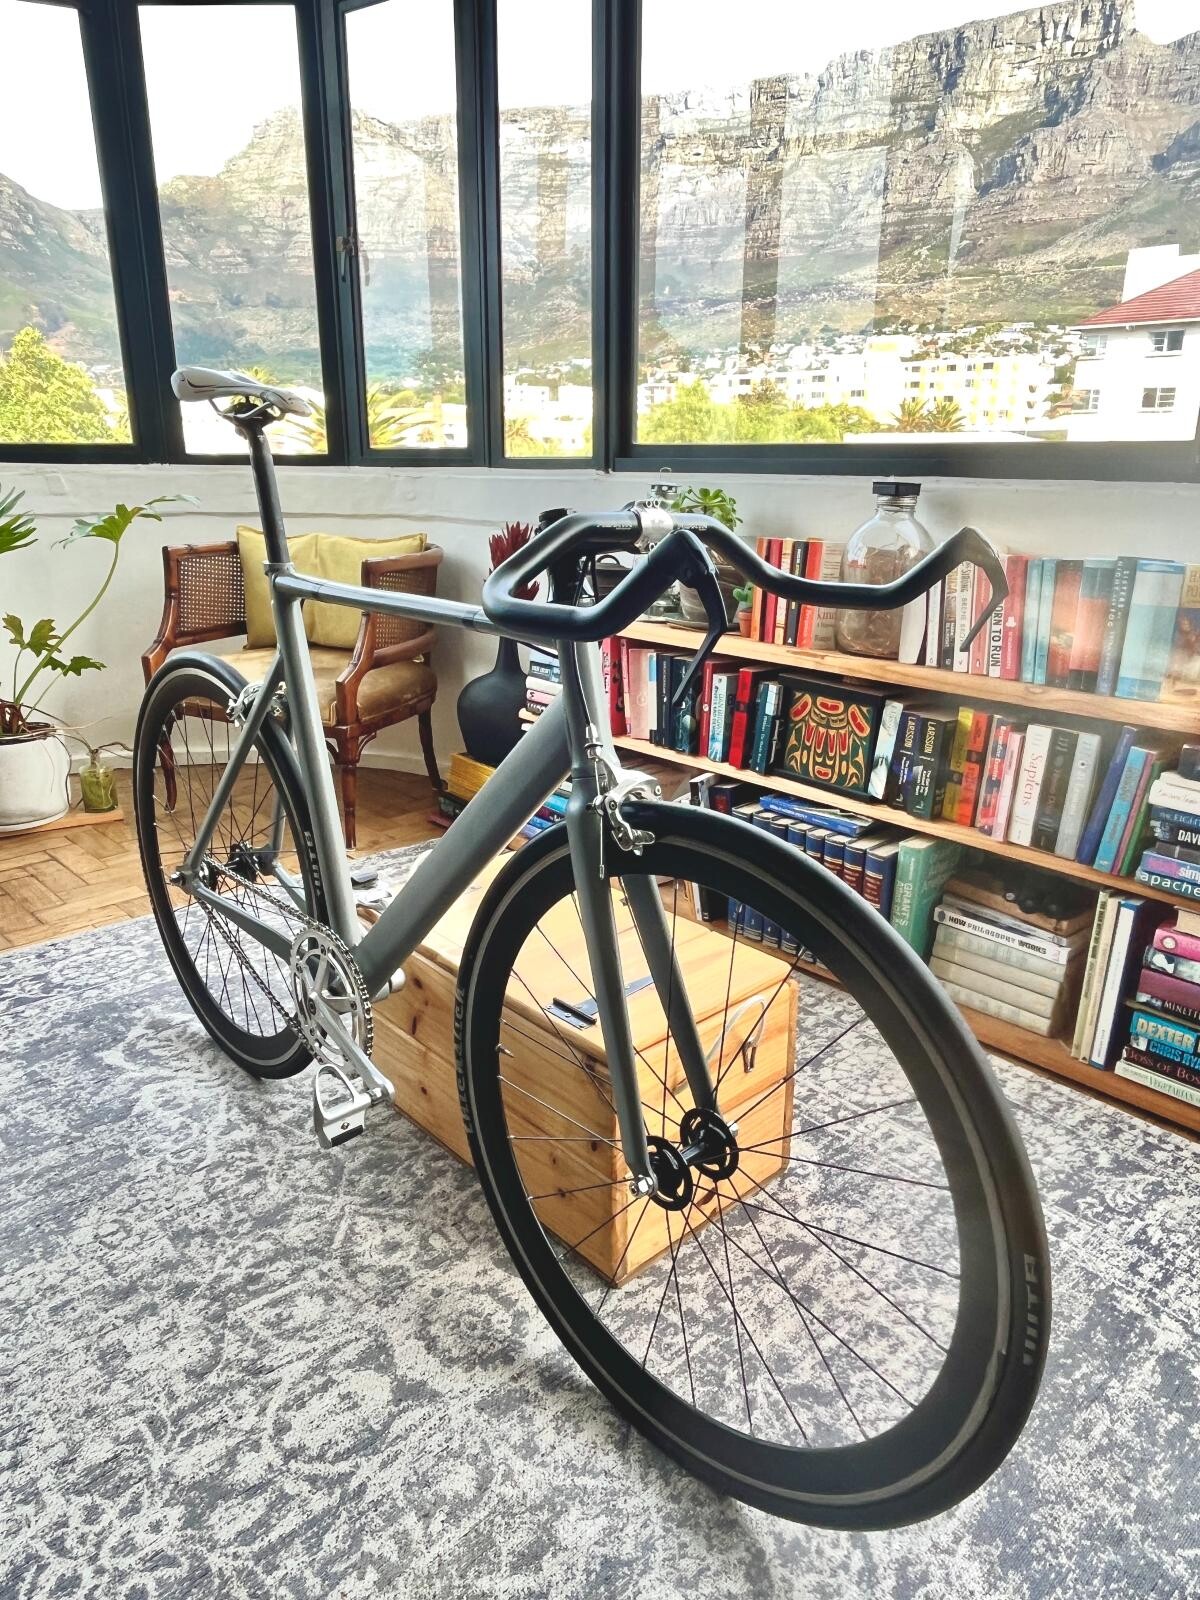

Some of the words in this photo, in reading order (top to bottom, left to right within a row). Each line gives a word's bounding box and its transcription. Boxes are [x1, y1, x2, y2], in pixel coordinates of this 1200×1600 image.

[993, 605, 1003, 626] ORN
[992, 628, 1002, 642] TO
[990, 645, 1001, 667] RUN
[904, 716, 916, 748] LARSSON
[924, 721, 936, 754] LARSSON
[1023, 753, 1043, 806] Sapiens
[1140, 872, 1200, 897] apache
[948, 915, 966, 927] HOW
[1018, 939, 1047, 955] WORKS
[1136, 1017, 1193, 1049] DEXTER
[1149, 1040, 1182, 1062] CHRIS
